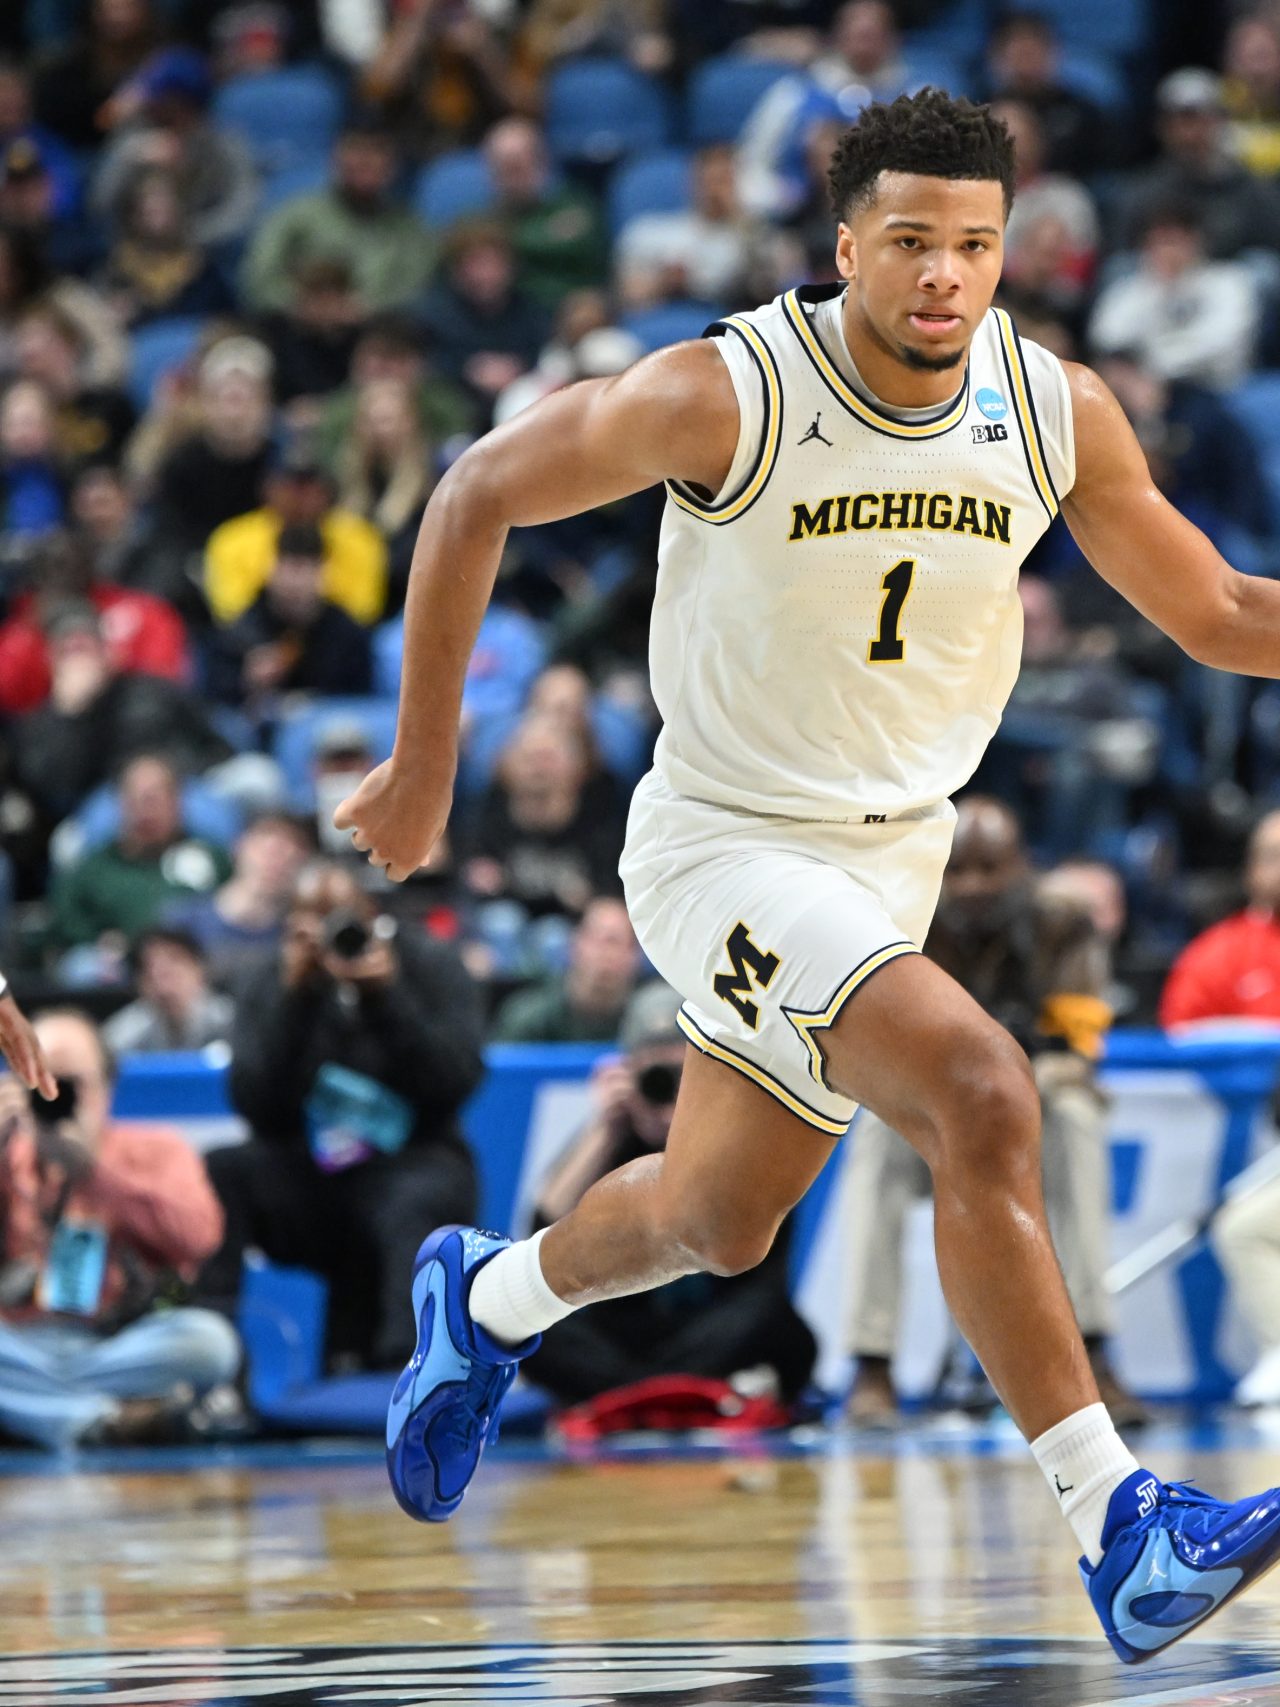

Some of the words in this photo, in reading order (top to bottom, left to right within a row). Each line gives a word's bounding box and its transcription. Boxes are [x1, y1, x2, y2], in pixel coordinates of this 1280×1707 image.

[787, 492, 1013, 546] MICHIGAN
[866, 558, 918, 665] 1
[713, 919, 783, 1033] M
